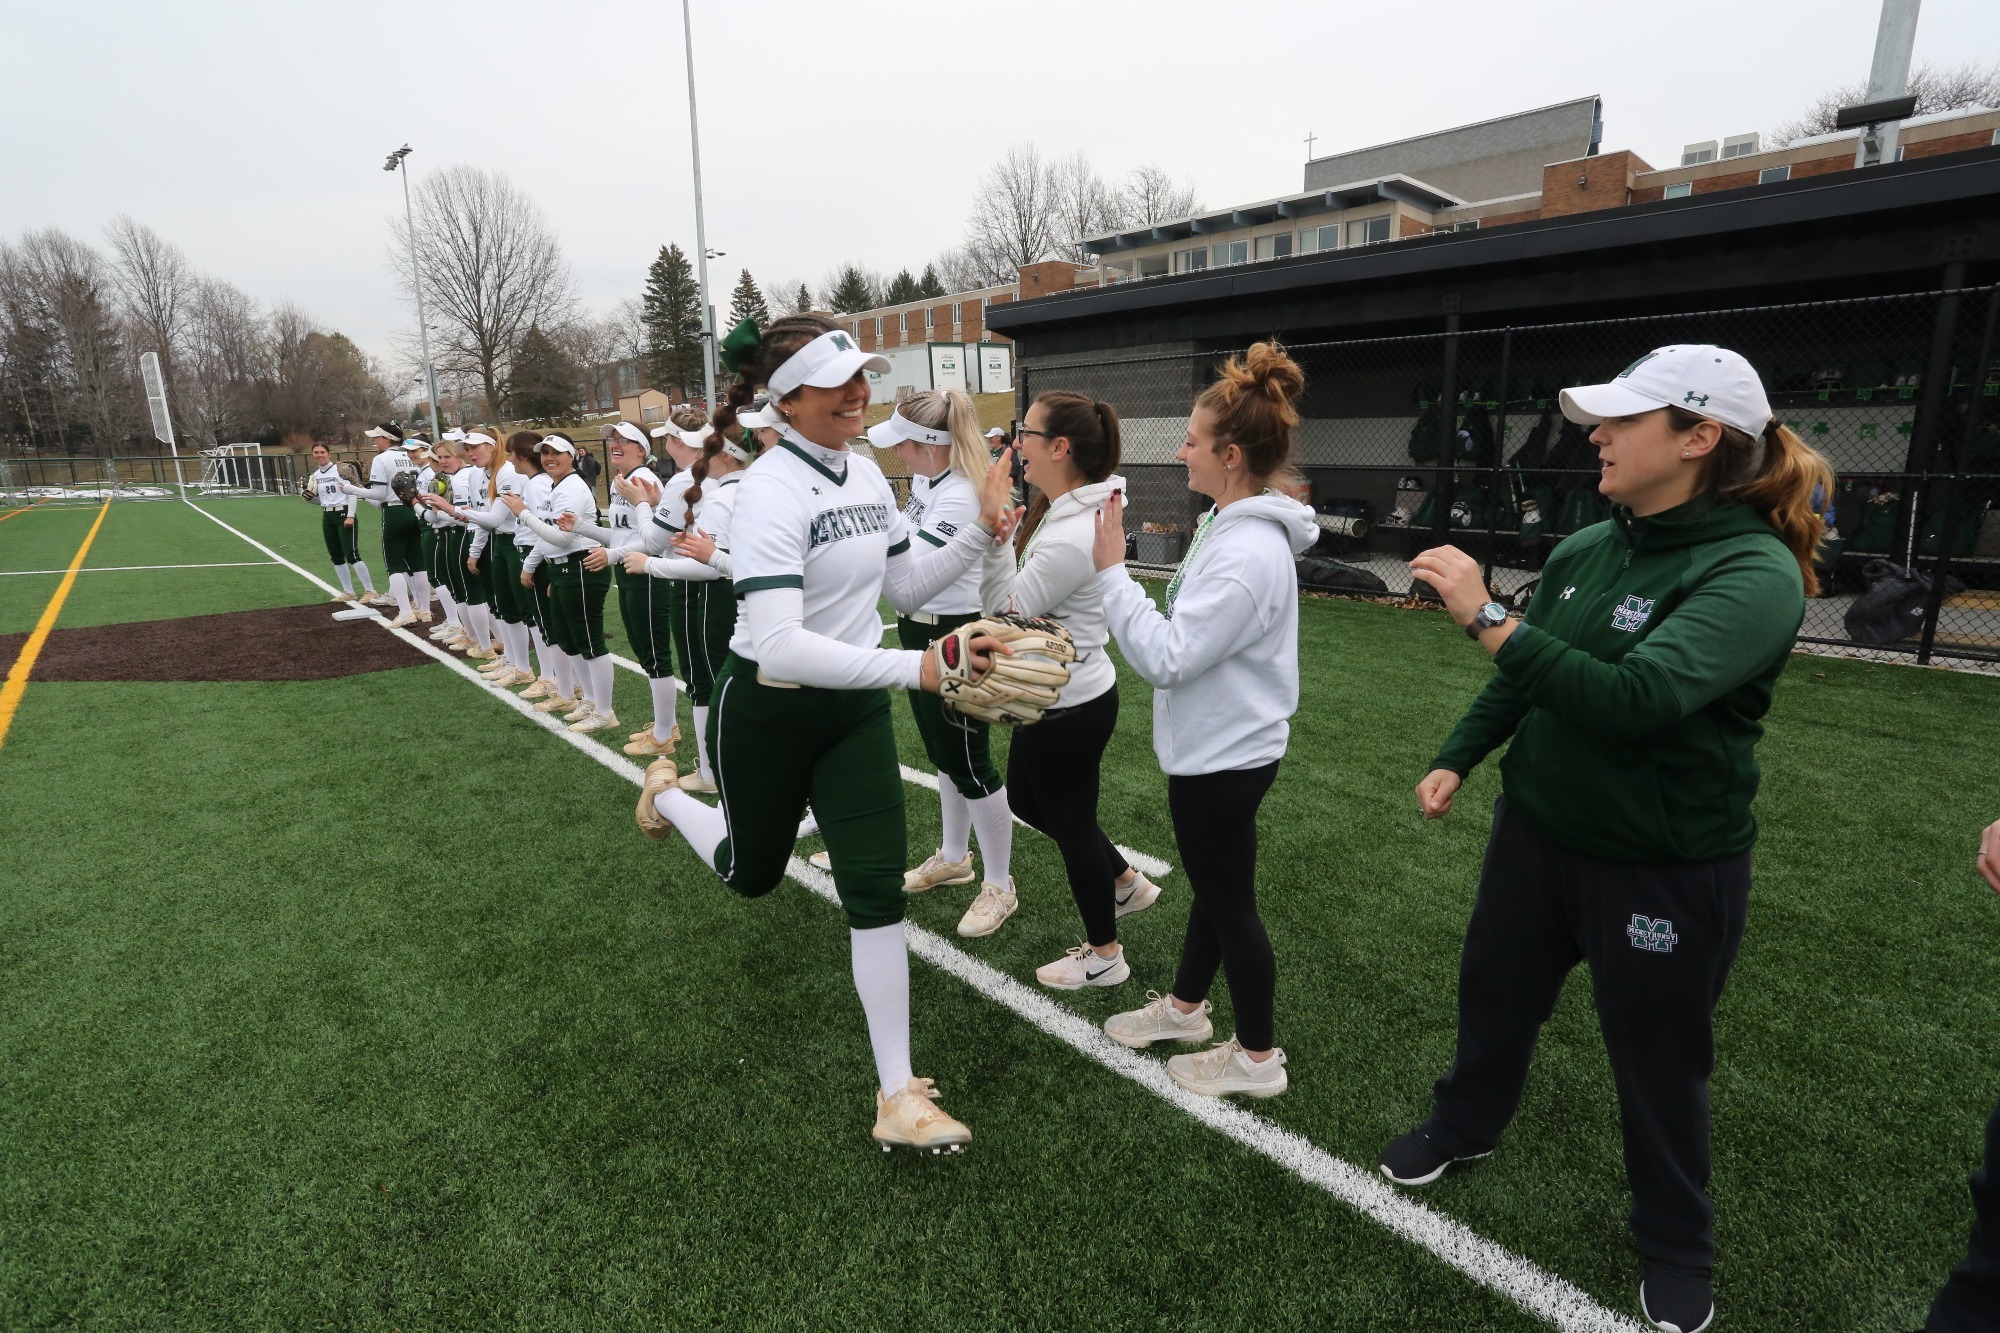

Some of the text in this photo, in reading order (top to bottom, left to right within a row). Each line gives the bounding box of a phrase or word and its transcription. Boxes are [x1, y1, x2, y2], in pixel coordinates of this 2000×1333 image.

[325, 485, 336, 494] 20
[614, 512, 633, 530] 14
[807, 502, 888, 550] MERCYHUR
[937, 522, 957, 536] PSAC
[1045, 640, 1067, 653] A2000
